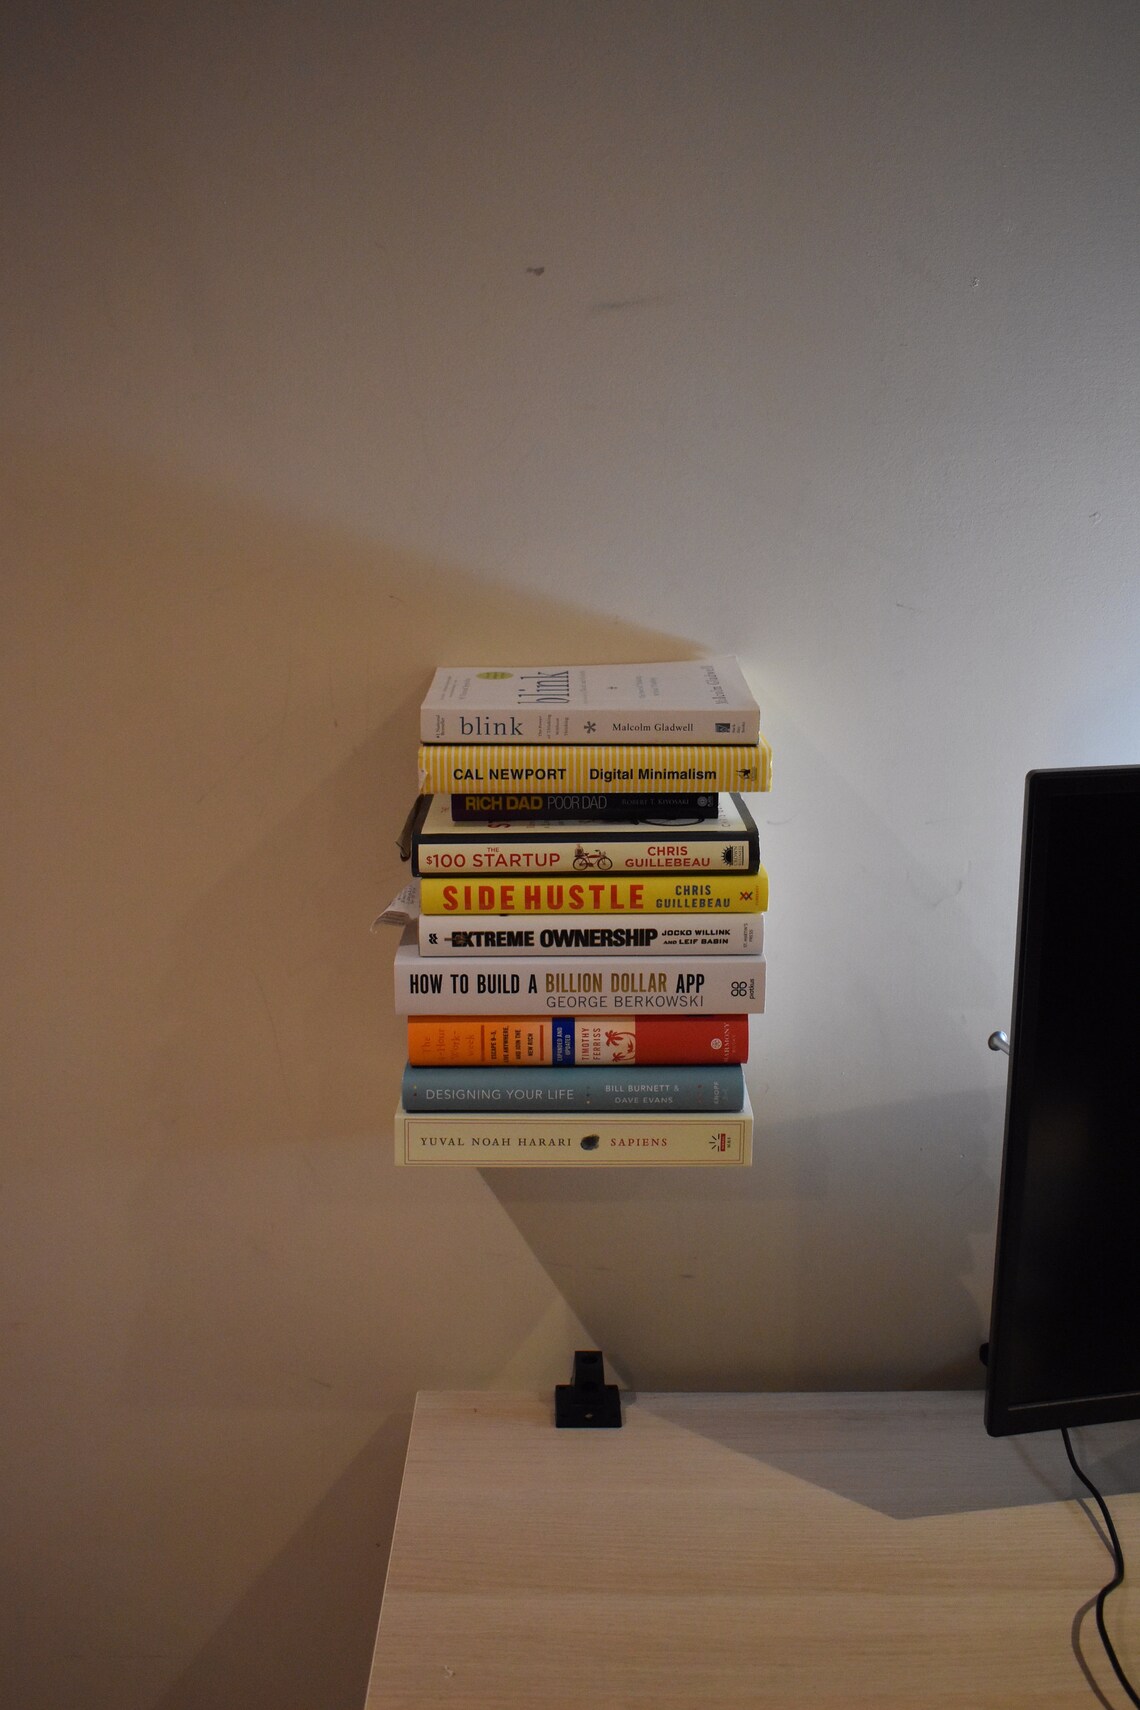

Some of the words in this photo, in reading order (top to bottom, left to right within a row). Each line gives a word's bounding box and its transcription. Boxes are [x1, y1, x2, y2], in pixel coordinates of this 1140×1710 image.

[517, 670, 570, 704] blink
[460, 716, 524, 736] blink
[612, 722, 650, 732] Malcolm
[654, 722, 694, 732] Gladwell
[453, 768, 484, 780] CAL
[489, 768, 566, 780] NEWPORT
[590, 768, 634, 782] Digital
[638, 768, 716, 780] Minimalism
[466, 796, 502, 810] RICH
[506, 796, 543, 810] DAD
[548, 796, 580, 810] POOR
[582, 796, 606, 810] DAD
[647, 846, 688, 856] CHRIS
[426, 854, 466, 868] $100
[472, 853, 560, 868] STARTUP
[625, 858, 710, 868] GUILLEBEAU
[676, 885, 712, 896] CHRIS
[442, 886, 515, 911] SIDE
[524, 884, 644, 910] HUSTLE
[656, 898, 730, 908] GUILLEBEAU
[452, 930, 534, 948] EXTREME
[540, 929, 658, 947] OWNERSHIP
[410, 974, 442, 994] HOW
[450, 974, 469, 994] TO
[477, 974, 520, 994] BUILD
[528, 974, 538, 994] A
[546, 973, 602, 993] BILLION
[611, 973, 667, 993] DOLLAR
[676, 974, 705, 994] APP
[546, 996, 608, 1008] GEORGE
[614, 996, 704, 1008] BERKOWSKI
[582, 1028, 590, 1060] TIMOTHY
[593, 1028, 601, 1060] FERRISS
[426, 1090, 501, 1100] DESIGNING
[506, 1089, 543, 1100] YOUR
[548, 1090, 574, 1100] LIFE
[420, 1138, 464, 1146] YUVAL
[472, 1138, 510, 1146] NOAH
[518, 1138, 572, 1146] HARARI
[610, 1138, 668, 1146] SAPIENS
